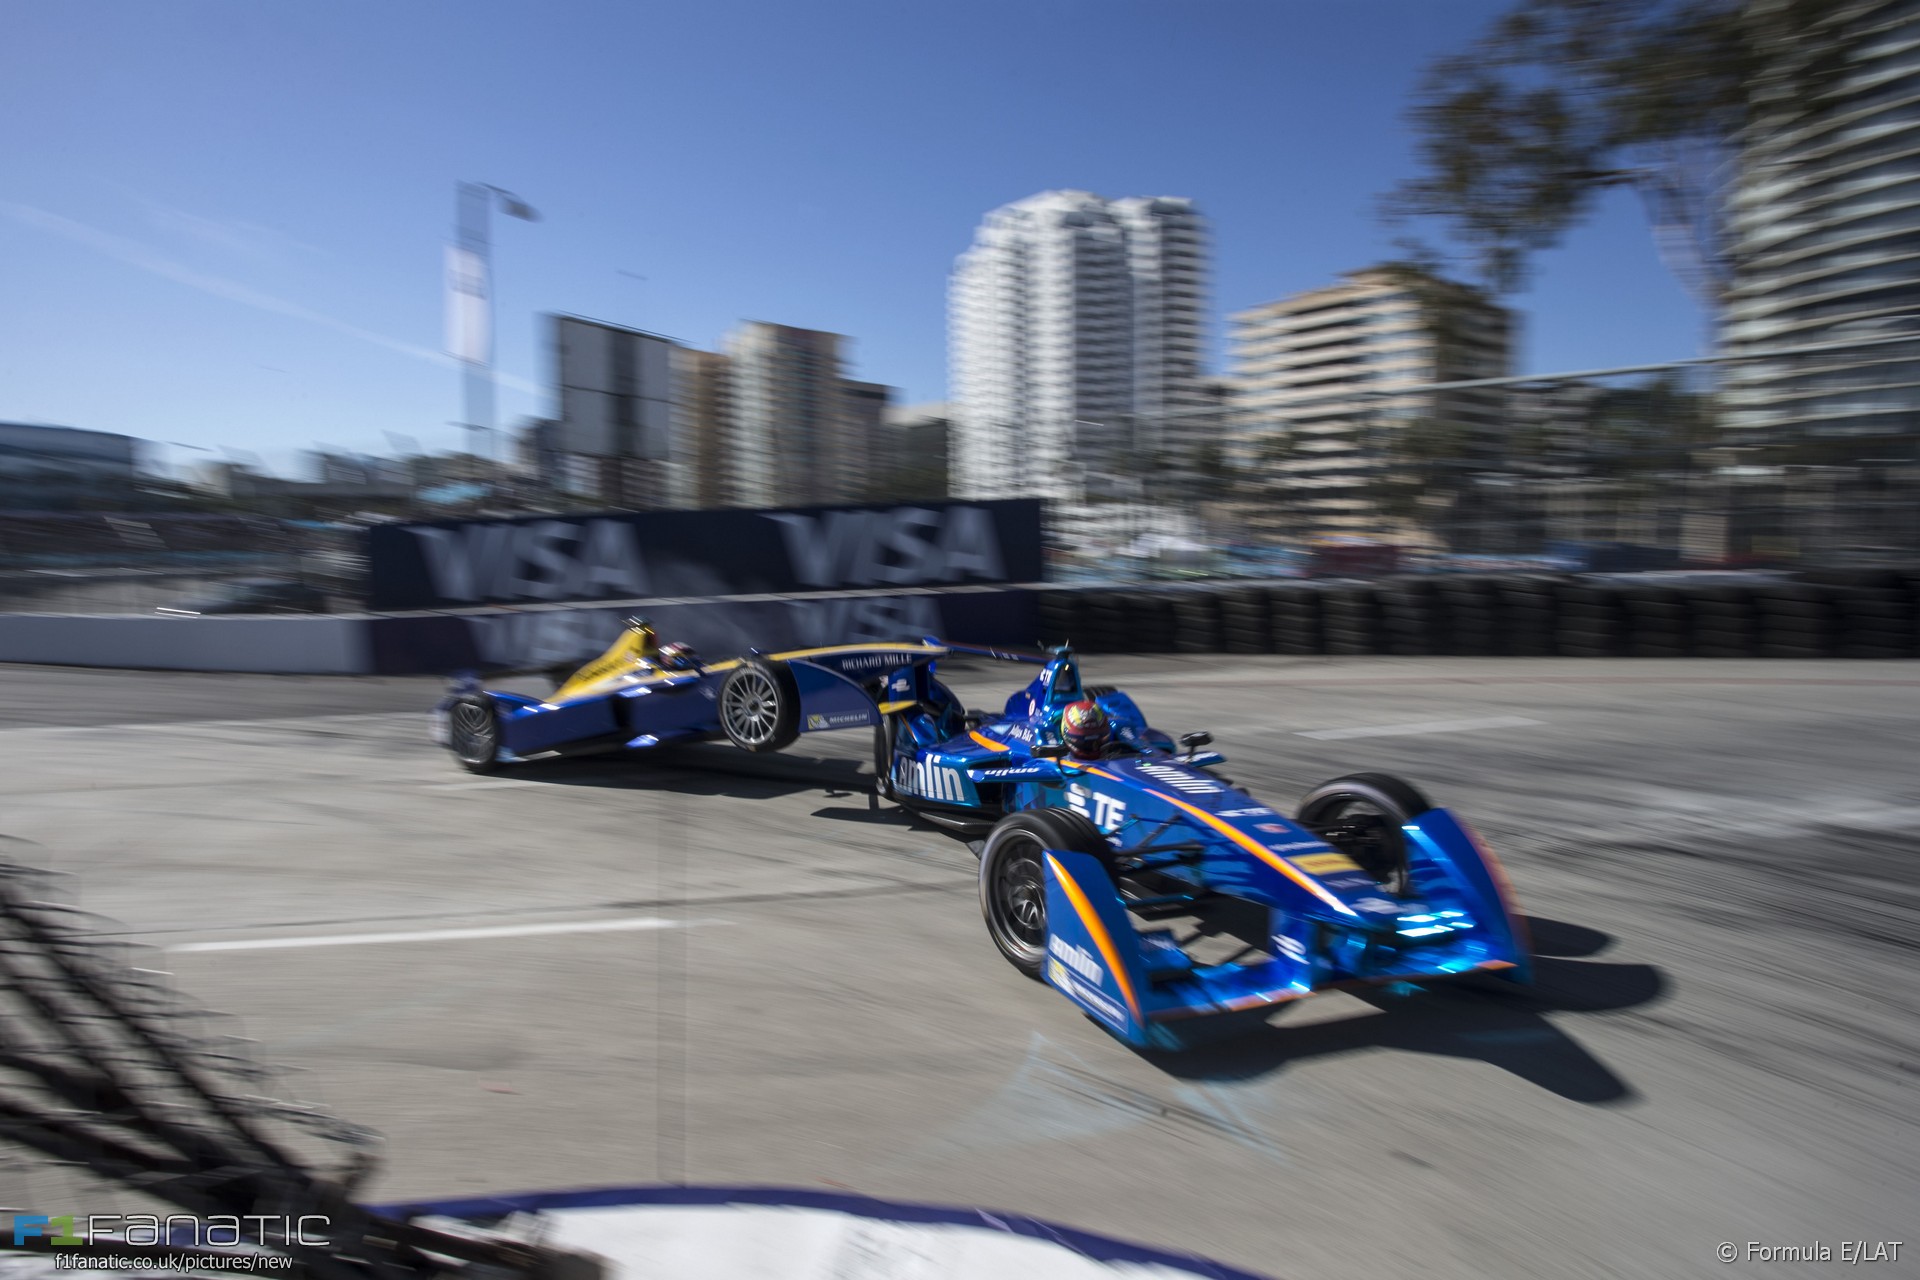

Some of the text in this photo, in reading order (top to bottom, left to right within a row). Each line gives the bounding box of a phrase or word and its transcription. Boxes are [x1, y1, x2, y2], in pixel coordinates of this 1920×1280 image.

[403, 518, 652, 601] VISA
[755, 506, 1008, 586] VISA
[780, 596, 949, 648] VISA
[842, 653, 912, 670] RICHARD MILLE
[829, 714, 868, 724] MICHELIN
[900, 752, 965, 802] amlin
[1092, 791, 1127, 831] TE
